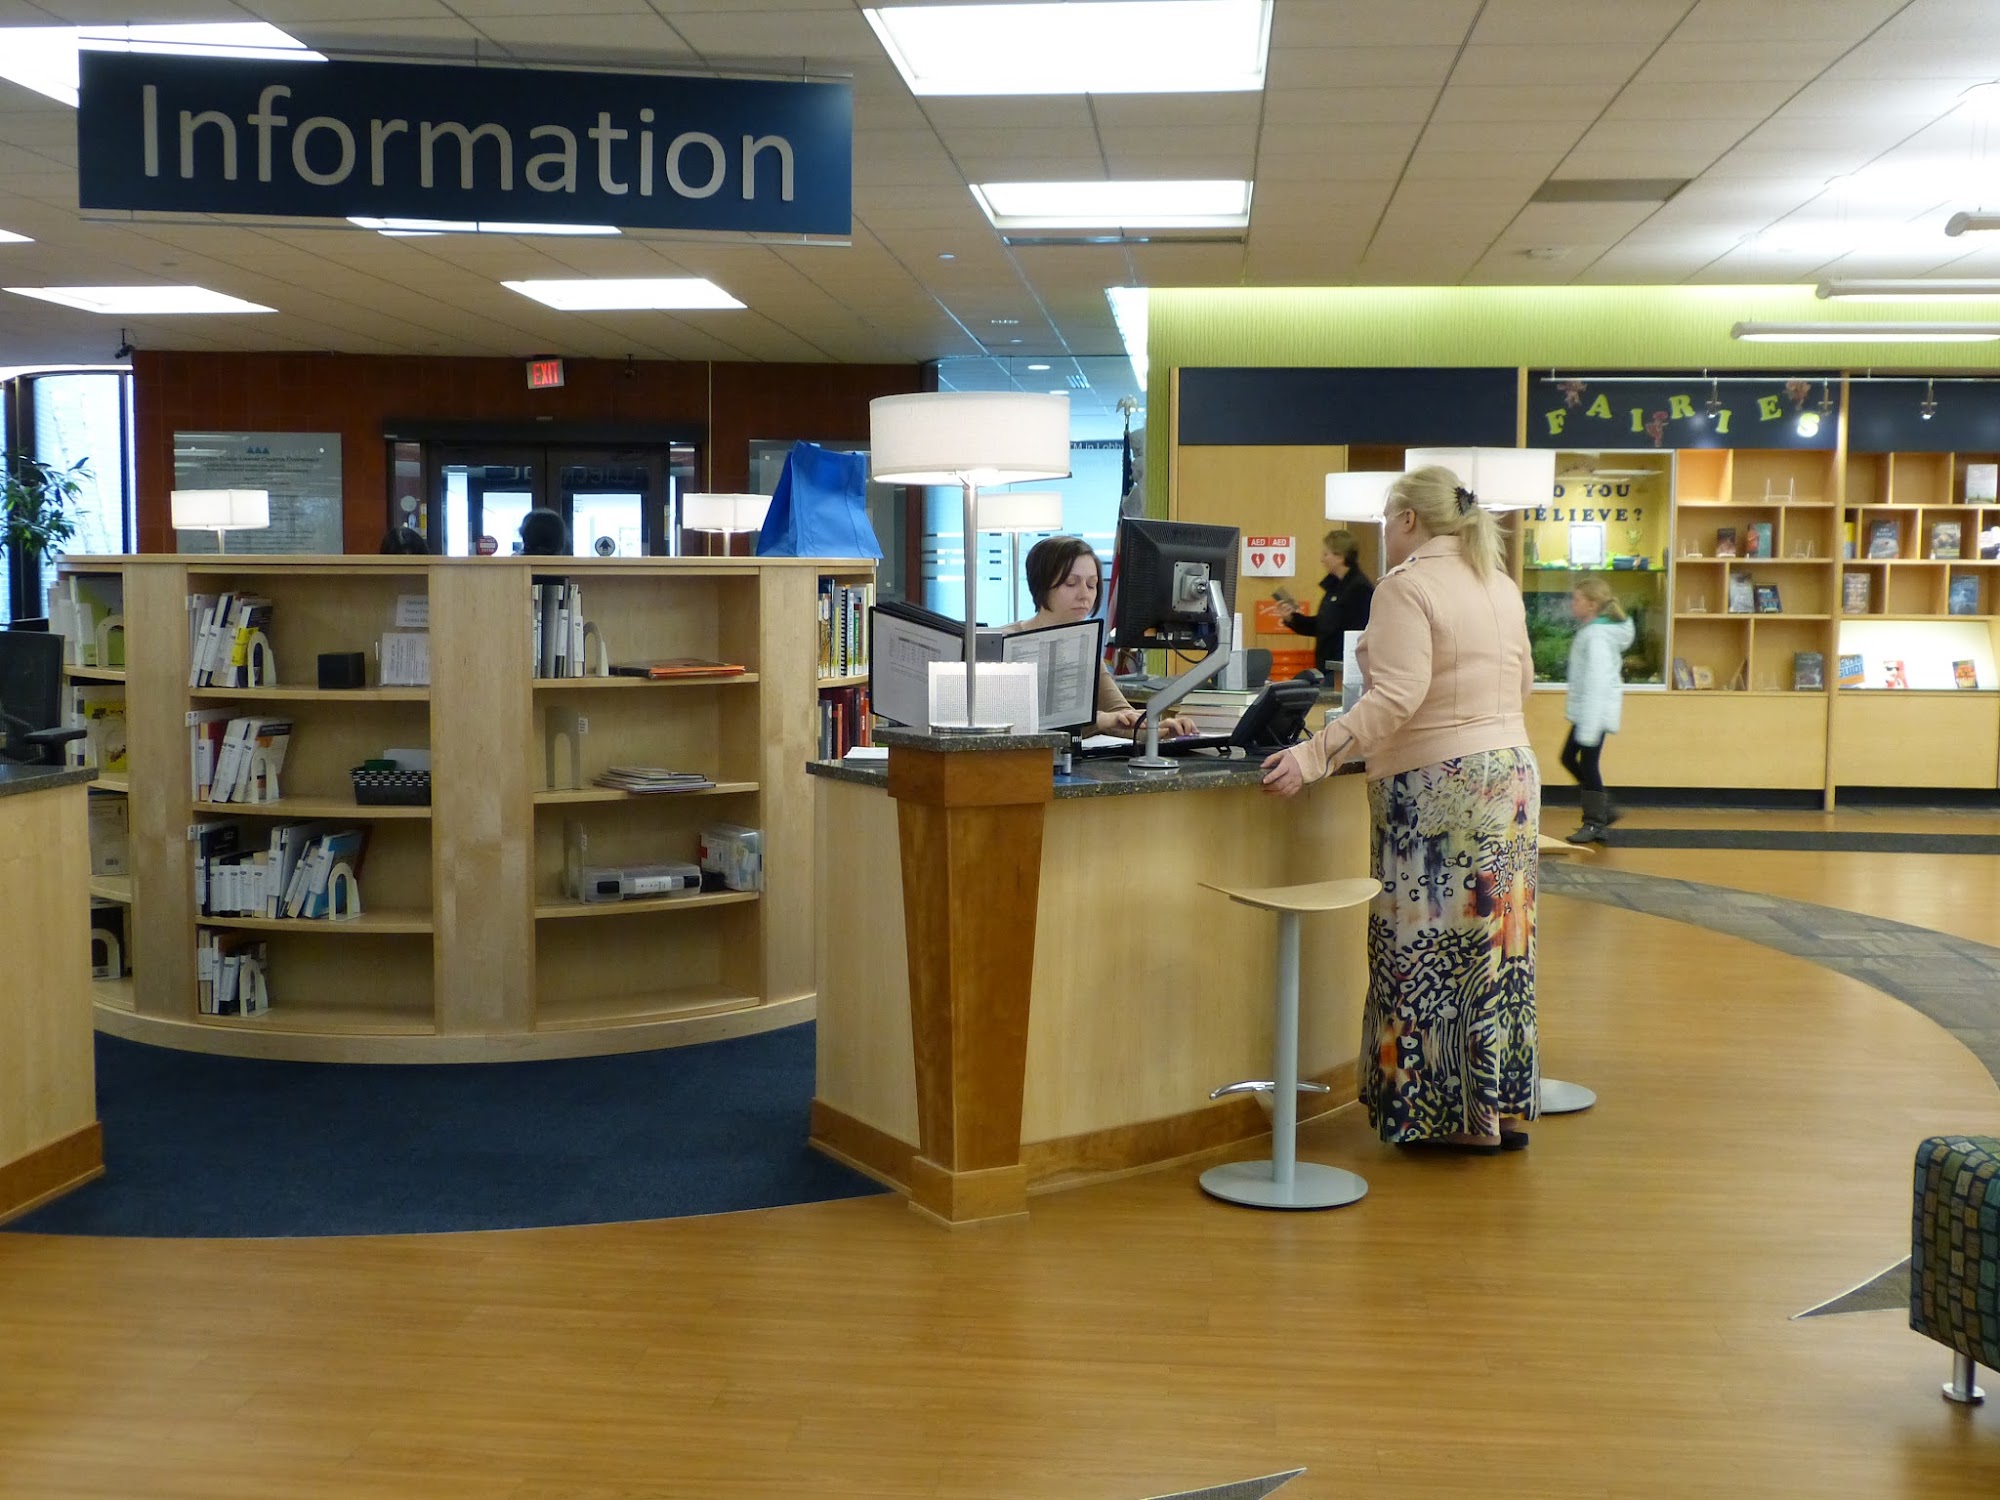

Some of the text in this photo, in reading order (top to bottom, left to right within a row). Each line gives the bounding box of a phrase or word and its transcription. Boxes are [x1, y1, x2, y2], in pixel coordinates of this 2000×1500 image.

[143, 84, 795, 203] Information
[532, 361, 559, 386] EXIT
[1546, 393, 1821, 438] FAIRIES
[1553, 484, 1631, 498] O YOU
[1250, 538, 1266, 546] AED
[1272, 538, 1288, 546] AED
